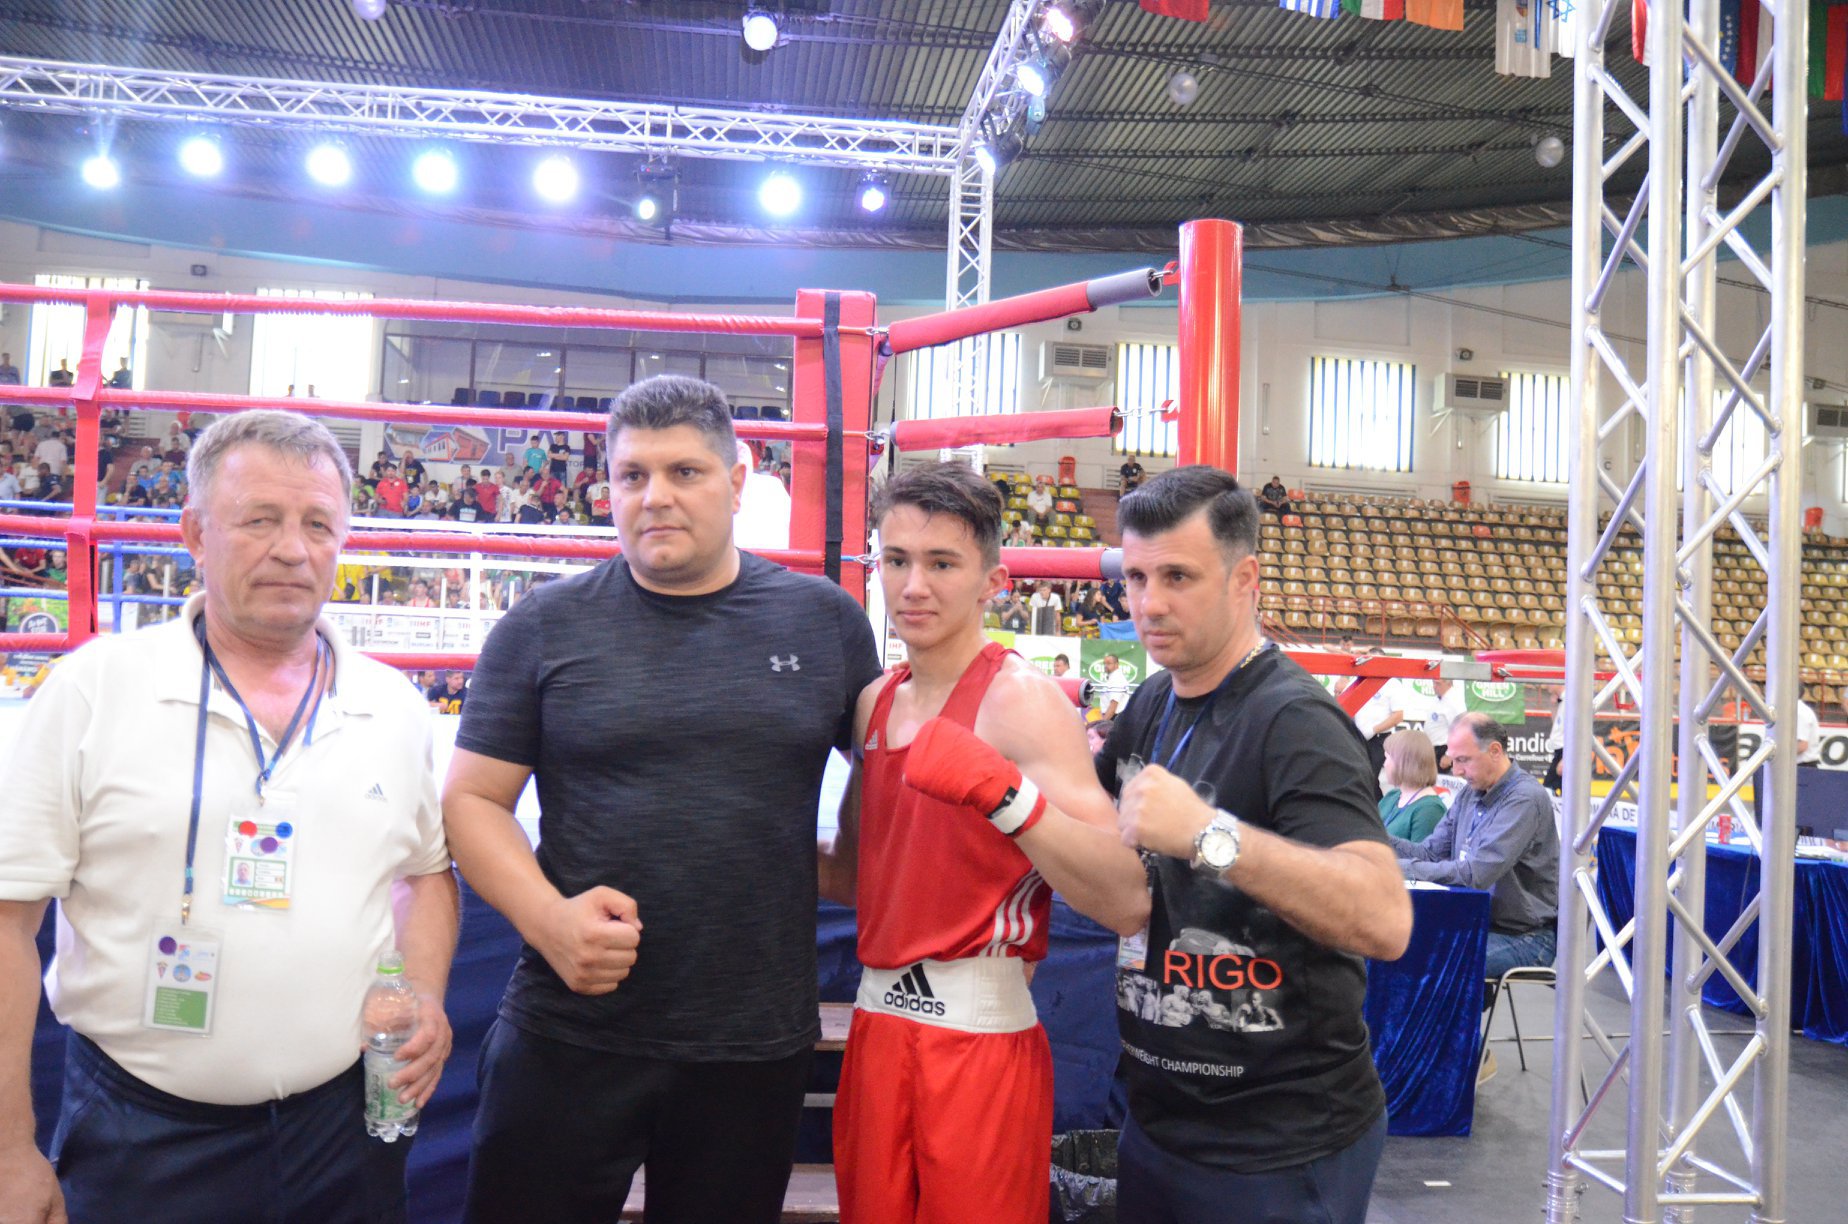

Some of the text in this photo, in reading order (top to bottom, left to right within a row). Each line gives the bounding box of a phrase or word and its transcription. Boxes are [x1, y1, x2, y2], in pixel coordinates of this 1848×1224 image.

[1482, 688, 1505, 698] HILL
[1163, 949, 1284, 991] RIGO
[884, 991, 946, 1017] adidas
[1161, 1057, 1245, 1079] CHAMPIONSHIP
